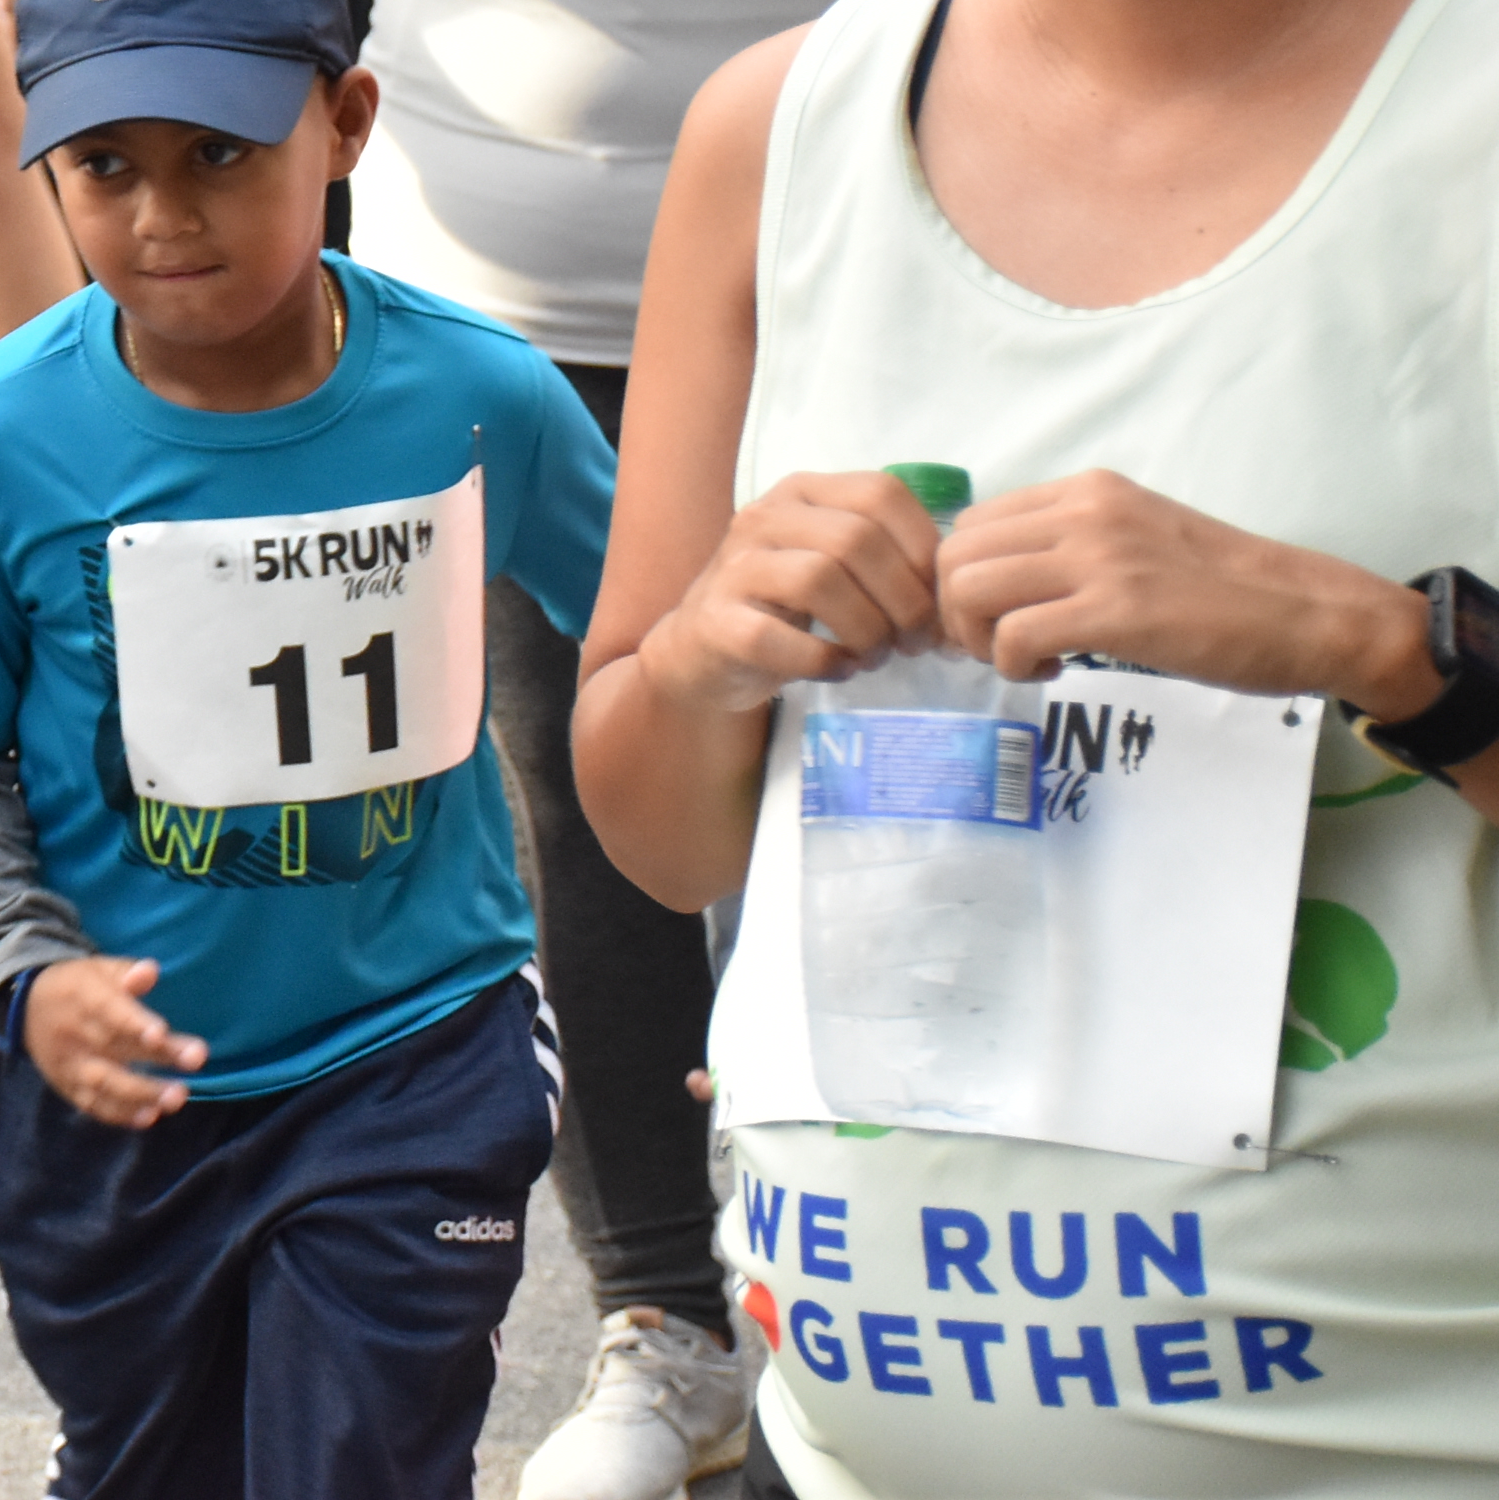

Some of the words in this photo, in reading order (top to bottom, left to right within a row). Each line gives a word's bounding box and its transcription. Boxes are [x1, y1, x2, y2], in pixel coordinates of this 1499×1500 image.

[253, 535, 313, 583] 5K
[318, 520, 412, 578] RUN
[342, 565, 410, 602] Walk
[249, 631, 400, 767] 11
[139, 780, 415, 877] WIN
[434, 1215, 516, 1241] adidas
[742, 1169, 853, 1283] WE
[920, 1206, 1207, 1299] RUN
